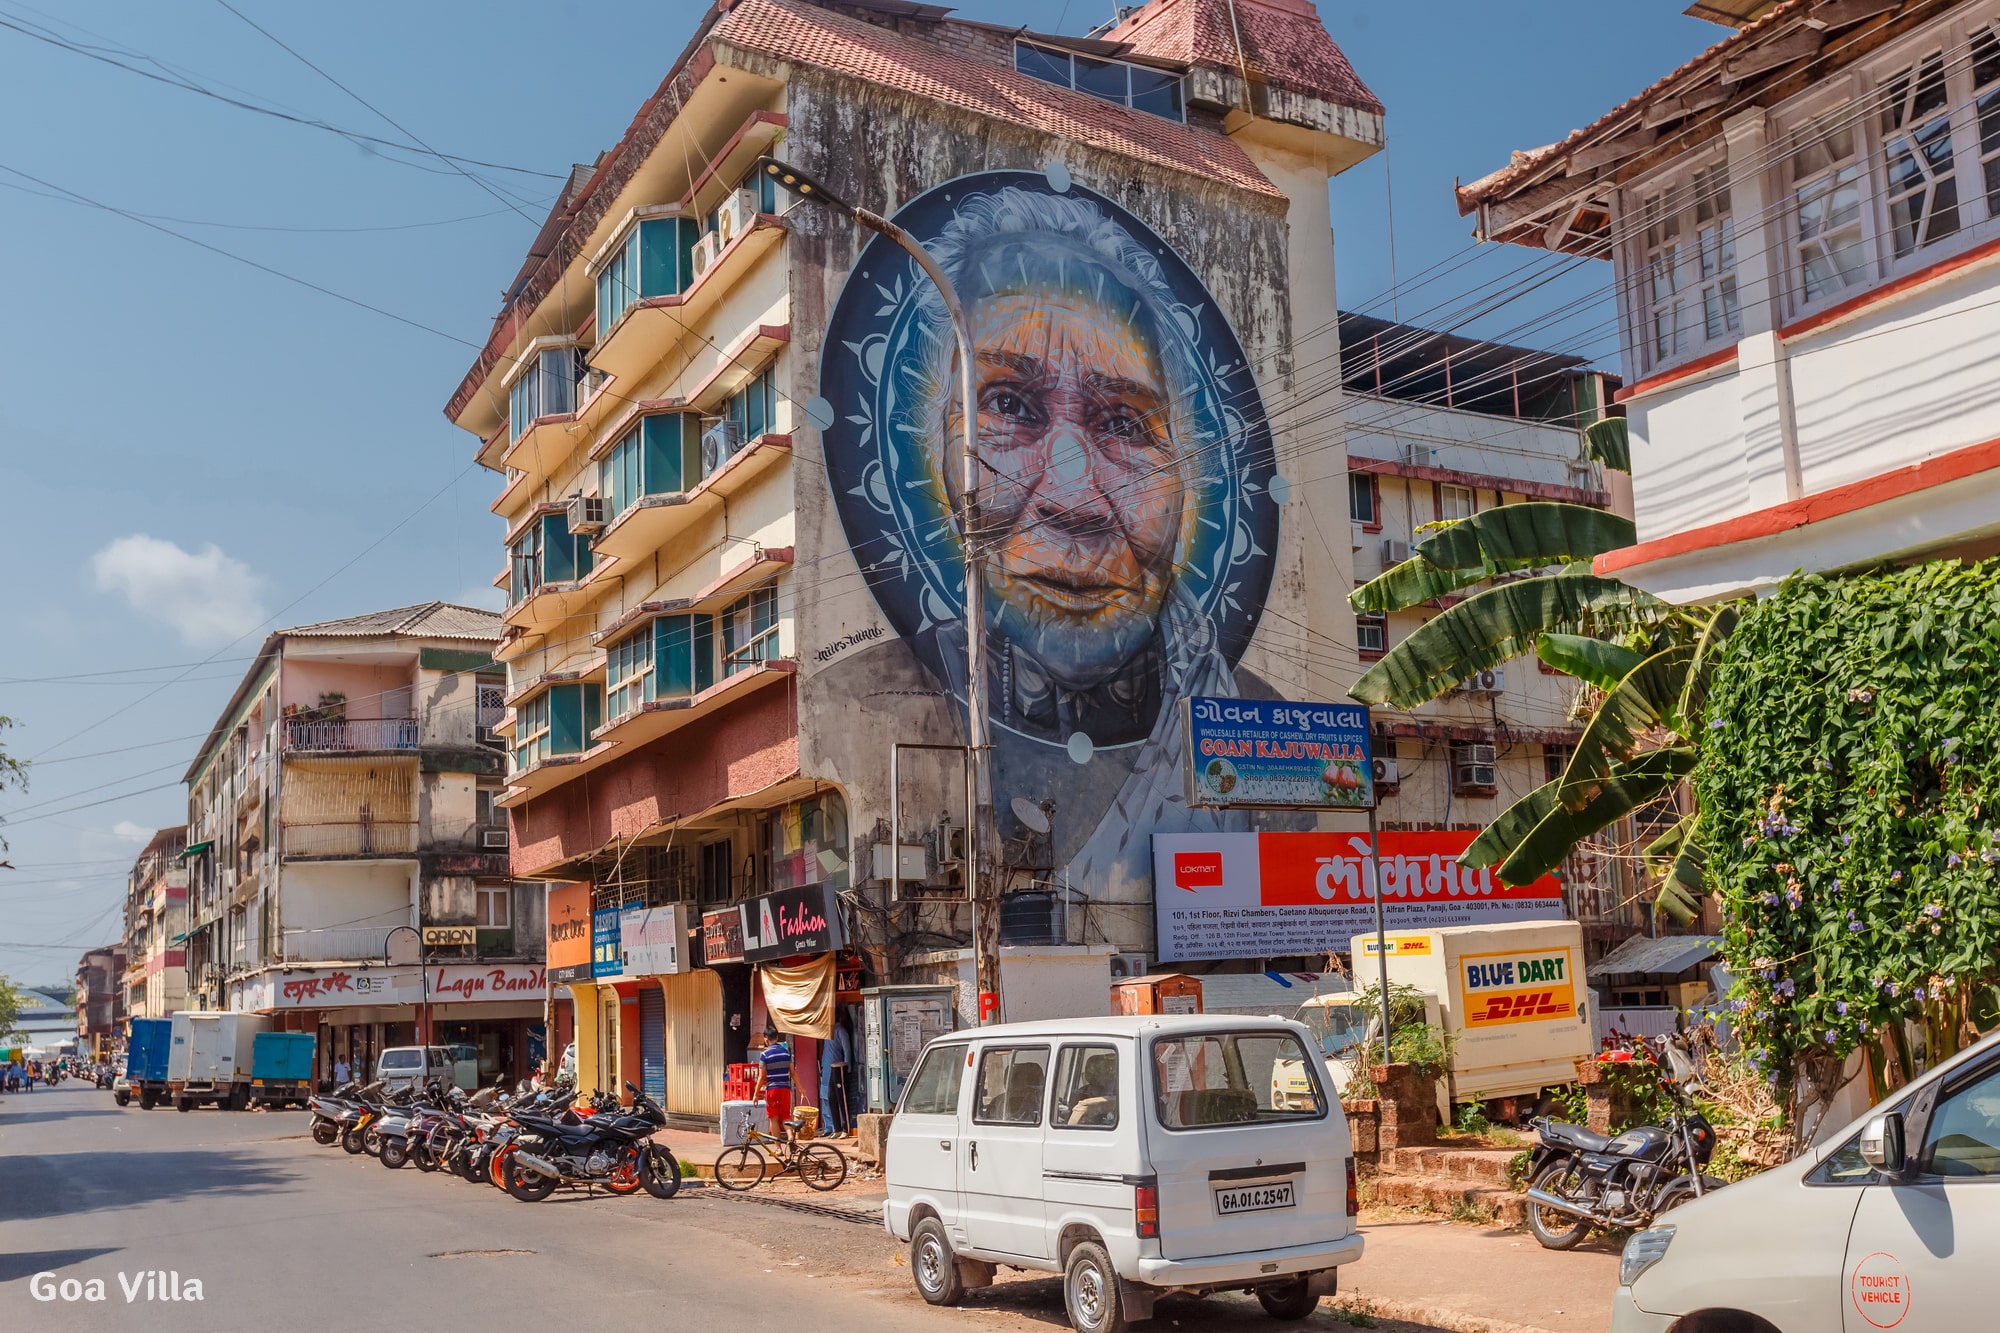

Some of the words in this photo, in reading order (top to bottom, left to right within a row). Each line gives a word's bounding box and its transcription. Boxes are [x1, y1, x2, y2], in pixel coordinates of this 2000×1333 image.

[1195, 700, 1263, 724] ગોવન
[1272, 707, 1364, 732] કાજુવાલા
[1201, 728, 1236, 738] WHOLESALE
[1237, 730, 1241, 738] &
[1242, 730, 1270, 739] RETAILER
[1271, 731, 1278, 739] OF
[1280, 732, 1305, 741] CASHEW,
[1306, 733, 1317, 741] DRY
[1318, 734, 1338, 742] FRUITS
[1338, 734, 1342, 742] &
[1344, 734, 1363, 743] SPICES
[1200, 738, 1253, 758] GOAN
[1256, 741, 1366, 761] KAJUWALLA
[1244, 774, 1263, 783] Shop
[1269, 774, 1317, 782] 0832-2220977
[1315, 836, 1492, 900] लोकमत
[1172, 911, 1188, 920] 101,
[1189, 911, 1200, 919] 1st
[1202, 910, 1222, 920] Floor,
[1224, 910, 1240, 918] Rizvi
[1242, 908, 1278, 918] Chambers,
[1279, 908, 1306, 916] Caetano
[1308, 907, 1349, 917] Albuquerque
[1351, 906, 1368, 915] Road,
[1406, 905, 1426, 913] Plaza,
[1426, 904, 1448, 912] Panaji,
[1466, 902, 1490, 910] 403001,
[1515, 901, 1534, 910] (0832)
[740, 898, 778, 950] LA
[779, 901, 826, 940] Fashion
[426, 929, 473, 944] ORION
[1404, 942, 1425, 950] DHL
[436, 968, 484, 998] Lagu
[486, 969, 547, 991] Bandh
[1468, 962, 1514, 988] BLUE
[1518, 958, 1564, 984] DART
[1486, 992, 1557, 1020] DHL
[1222, 1188, 1290, 1210] GA.01.C.2547
[1860, 1276, 1900, 1288] TOURIST
[1861, 1292, 1900, 1303] VEHICLE
